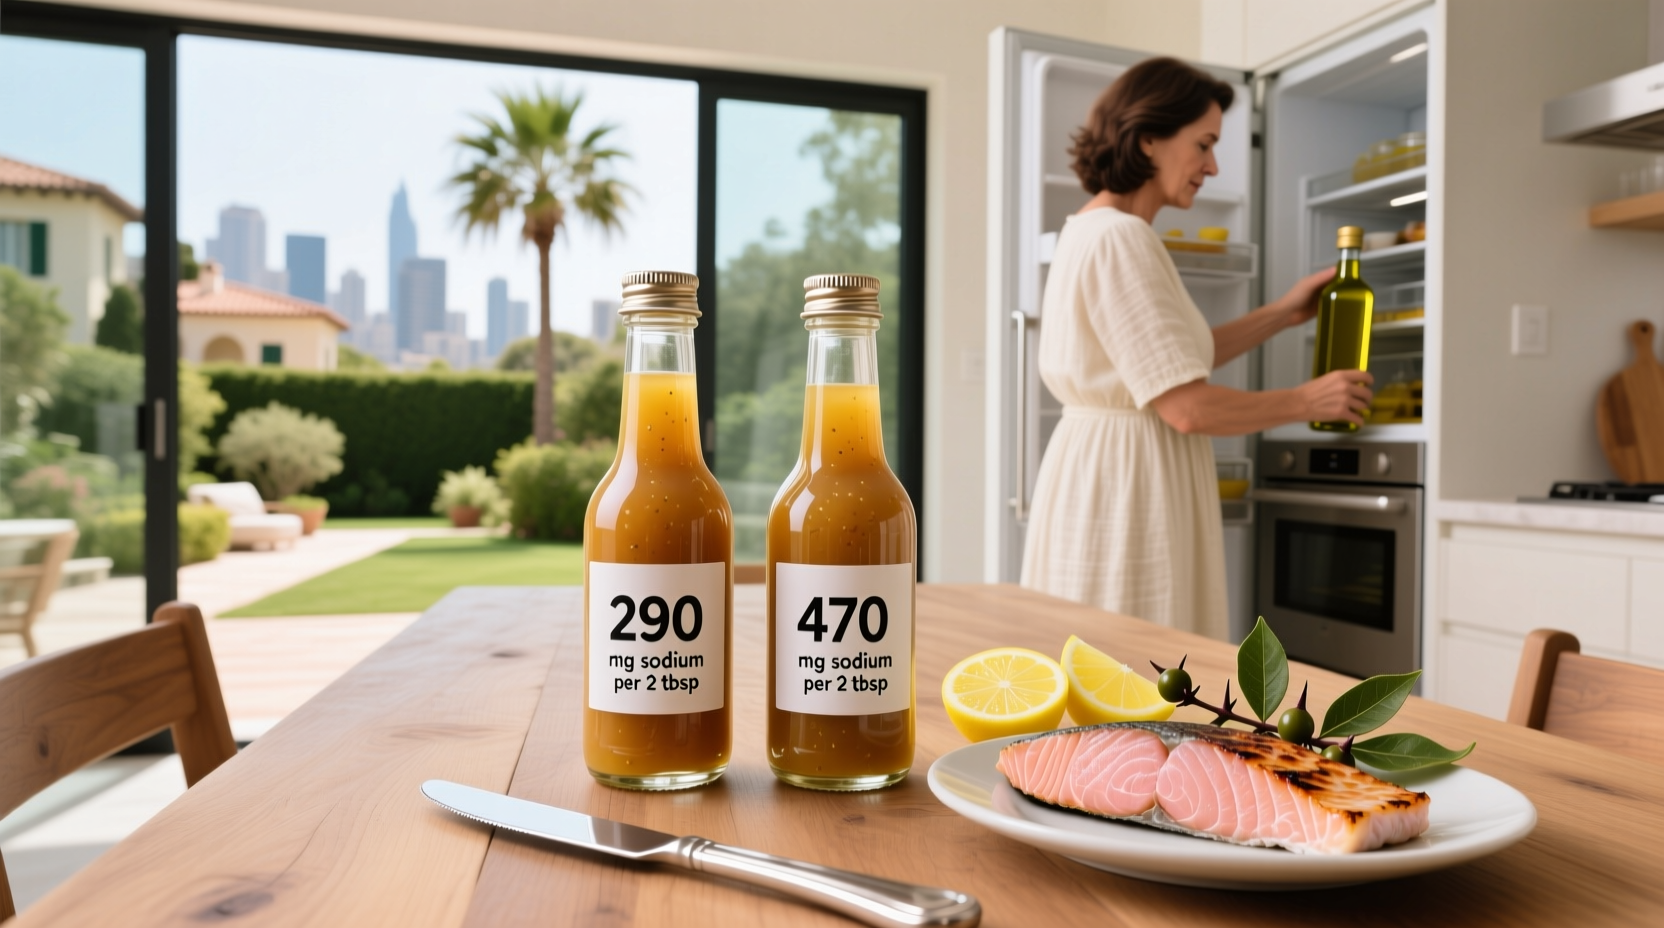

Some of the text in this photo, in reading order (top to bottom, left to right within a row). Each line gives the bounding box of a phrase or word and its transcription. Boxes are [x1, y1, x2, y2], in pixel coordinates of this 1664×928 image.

[610, 595, 703, 642] 290
[797, 596, 888, 643] 470
[610, 651, 704, 672] mg sodium
[799, 652, 892, 673] mg sodium
[615, 673, 699, 695] per 2 tbsp
[804, 674, 888, 696] per 2 tbsp
